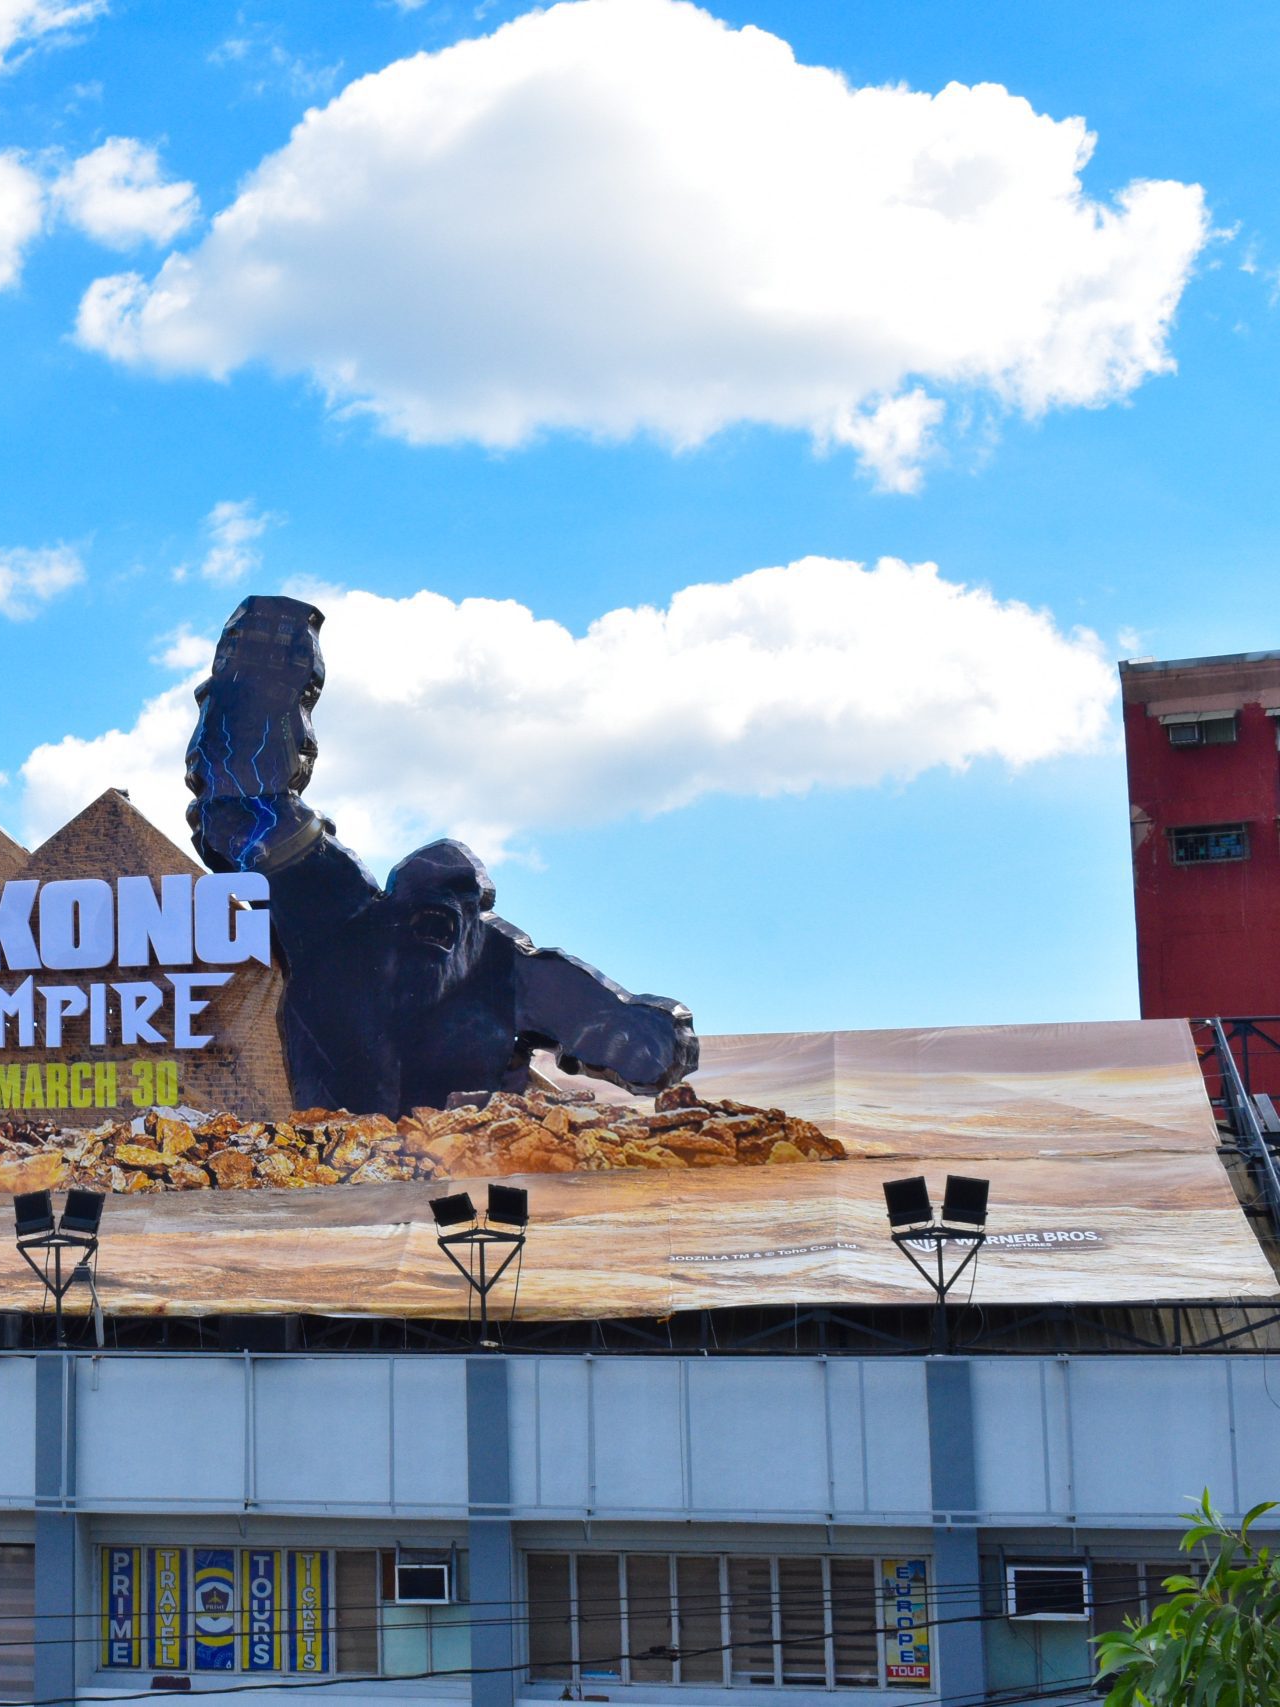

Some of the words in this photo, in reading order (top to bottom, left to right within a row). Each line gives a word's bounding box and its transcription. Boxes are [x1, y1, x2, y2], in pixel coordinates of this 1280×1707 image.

[131, 1060, 179, 1109] 30
[778, 1247, 807, 1256] Toho
[1043, 1231, 1103, 1242] BROS.
[110, 1552, 132, 1663] PRIME
[159, 1552, 176, 1665] TRAVEL
[251, 1555, 272, 1664] TOURS
[302, 1554, 317, 1669] TICKETS
[895, 1566, 915, 1663] EUROPE
[890, 1666, 925, 1676] TOUR
